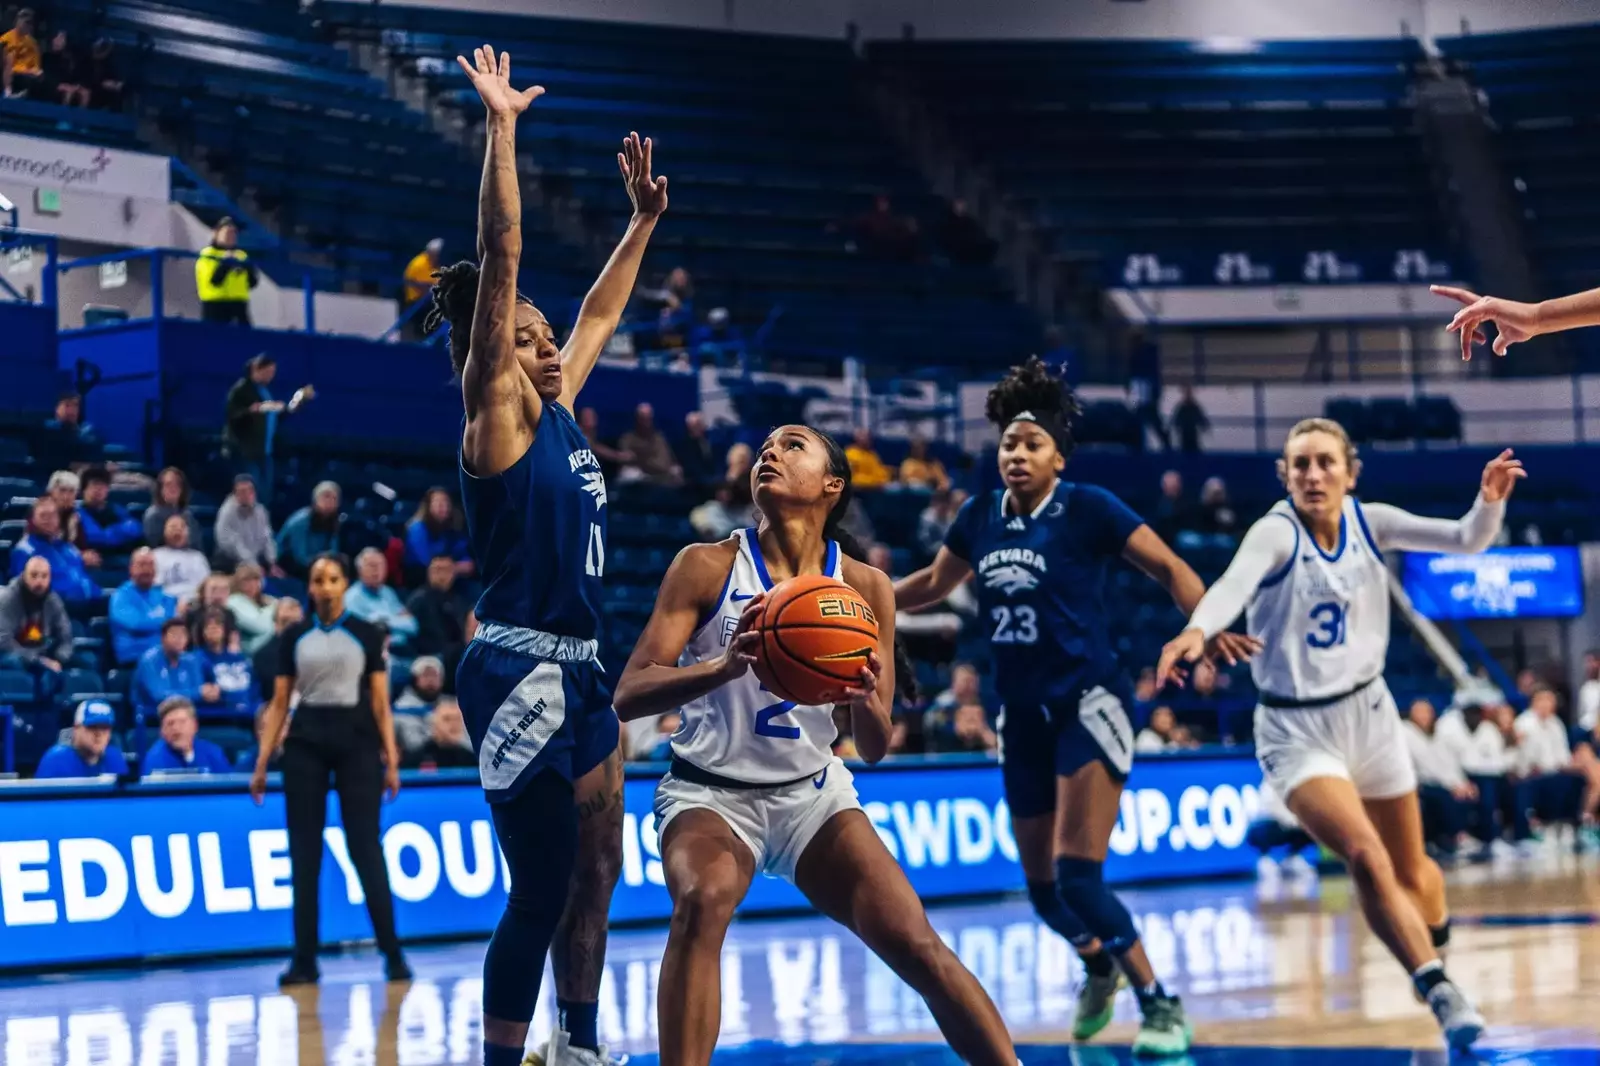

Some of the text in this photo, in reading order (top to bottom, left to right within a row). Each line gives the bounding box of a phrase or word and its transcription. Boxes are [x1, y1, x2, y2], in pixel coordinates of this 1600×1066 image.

[585, 521, 605, 578] 11
[978, 548, 1047, 574] NEVADA
[818, 598, 876, 625] ELITE
[991, 605, 1038, 645] 23
[492, 697, 547, 770] BATTLE READY
[0, 828, 294, 926] EDULE
[323, 819, 512, 904] YOU
